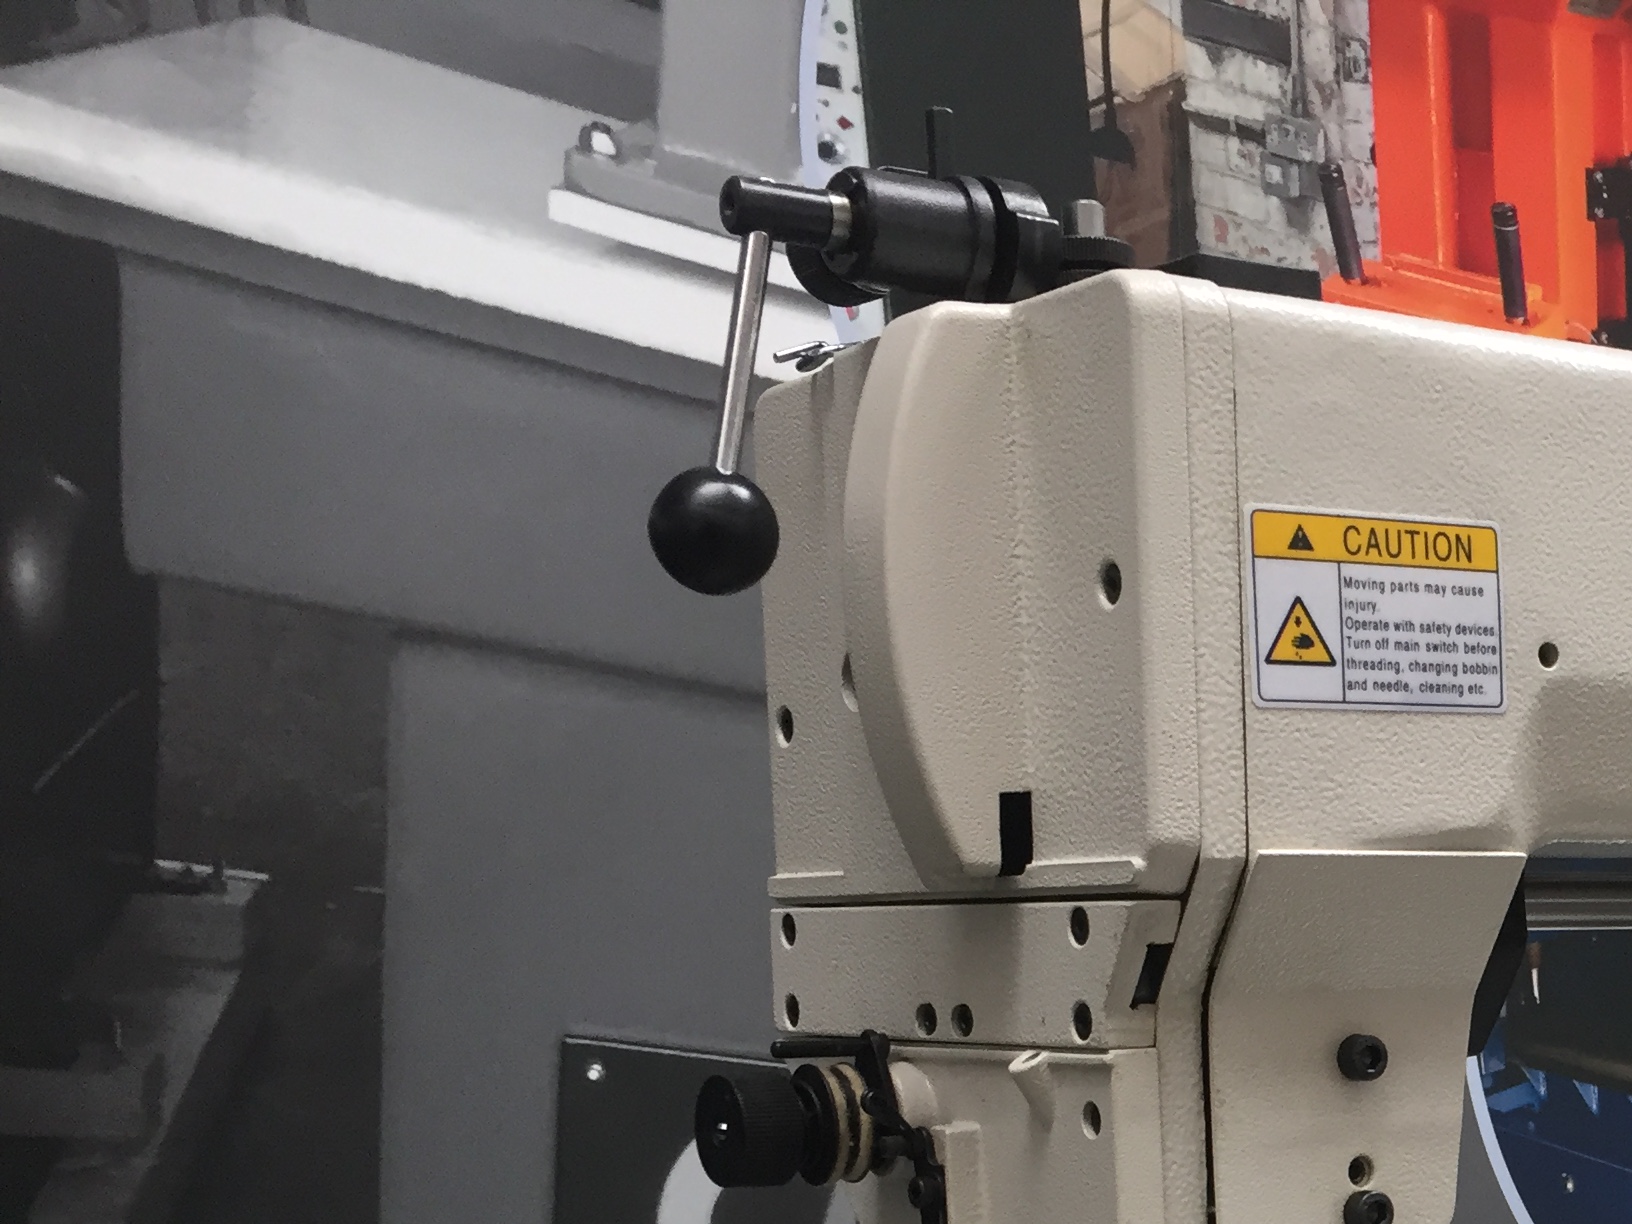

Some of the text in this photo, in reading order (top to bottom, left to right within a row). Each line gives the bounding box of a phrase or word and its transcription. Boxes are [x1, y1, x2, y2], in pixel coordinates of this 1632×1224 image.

[1343, 525, 1472, 564] CAUTION
[1343, 576, 1484, 598] Moving parts may cause
[1345, 617, 1390, 633] Operate
[1393, 620, 1416, 633] with
[1419, 621, 1452, 638] safety
[1346, 636, 1497, 656] Turn off main switch before
[1346, 658, 1498, 677] threading, changing bobbin
[1347, 679, 1368, 691] and
[1372, 680, 1413, 694] needle,
[1419, 681, 1464, 698] cleaning
